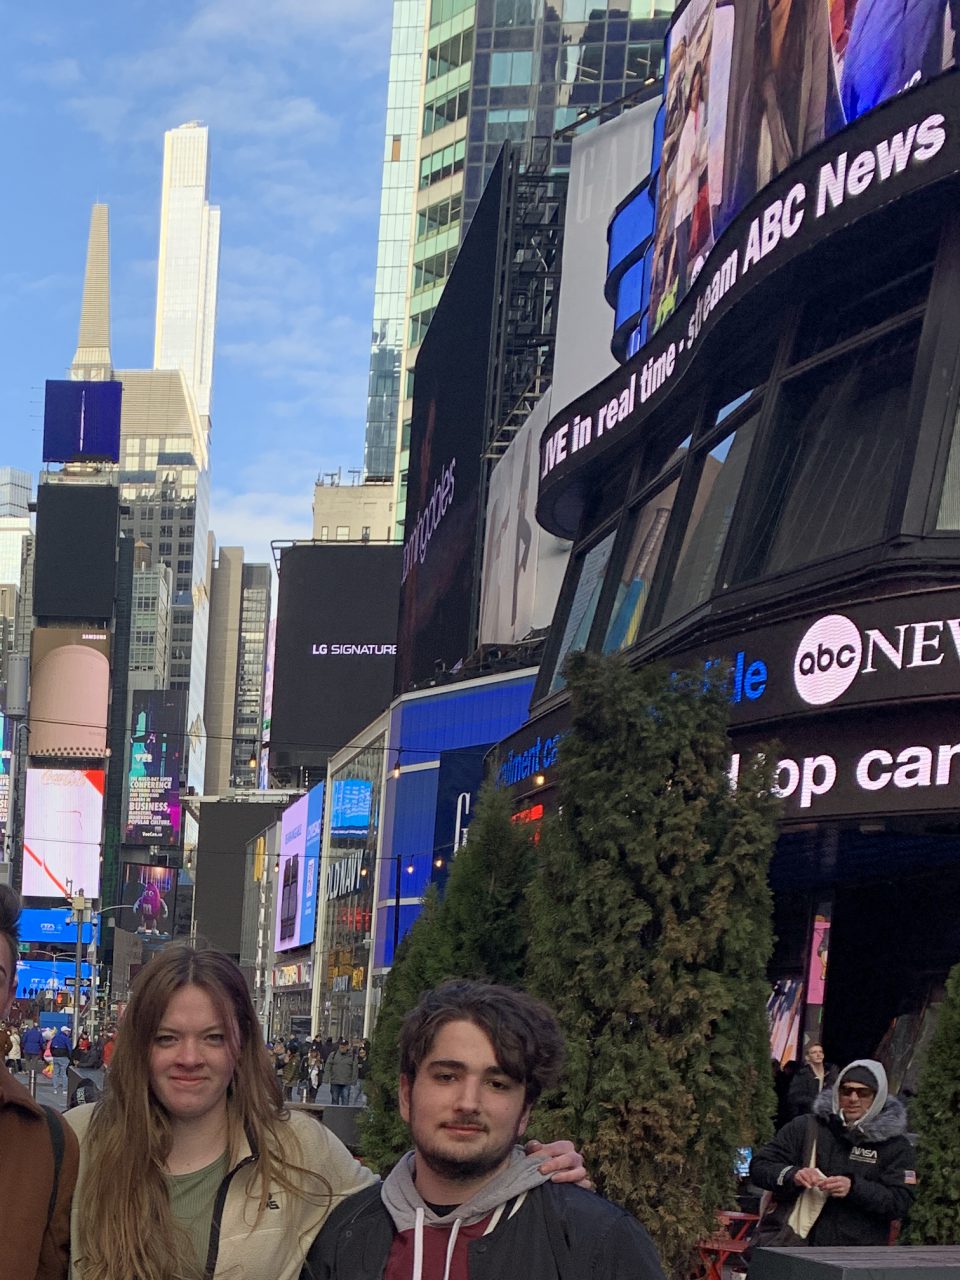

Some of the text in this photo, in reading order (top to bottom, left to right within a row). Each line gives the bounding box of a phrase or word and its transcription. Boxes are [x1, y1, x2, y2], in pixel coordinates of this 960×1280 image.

[570, 415, 592, 454] in
[596, 373, 637, 438] real
[640, 342, 676, 404] time
[688, 249, 739, 350] stream
[742, 182, 807, 275] ABC
[815, 113, 947, 218] News
[312, 644, 397, 655] LG SIGNATURE
[798, 642, 857, 677] abc
[130, 781, 172, 789] CONFERENCE
[129, 802, 171, 813] BUSINESS,
[326, 849, 364, 900] OLD NAVY
[851, 1146, 878, 1159] NASA
